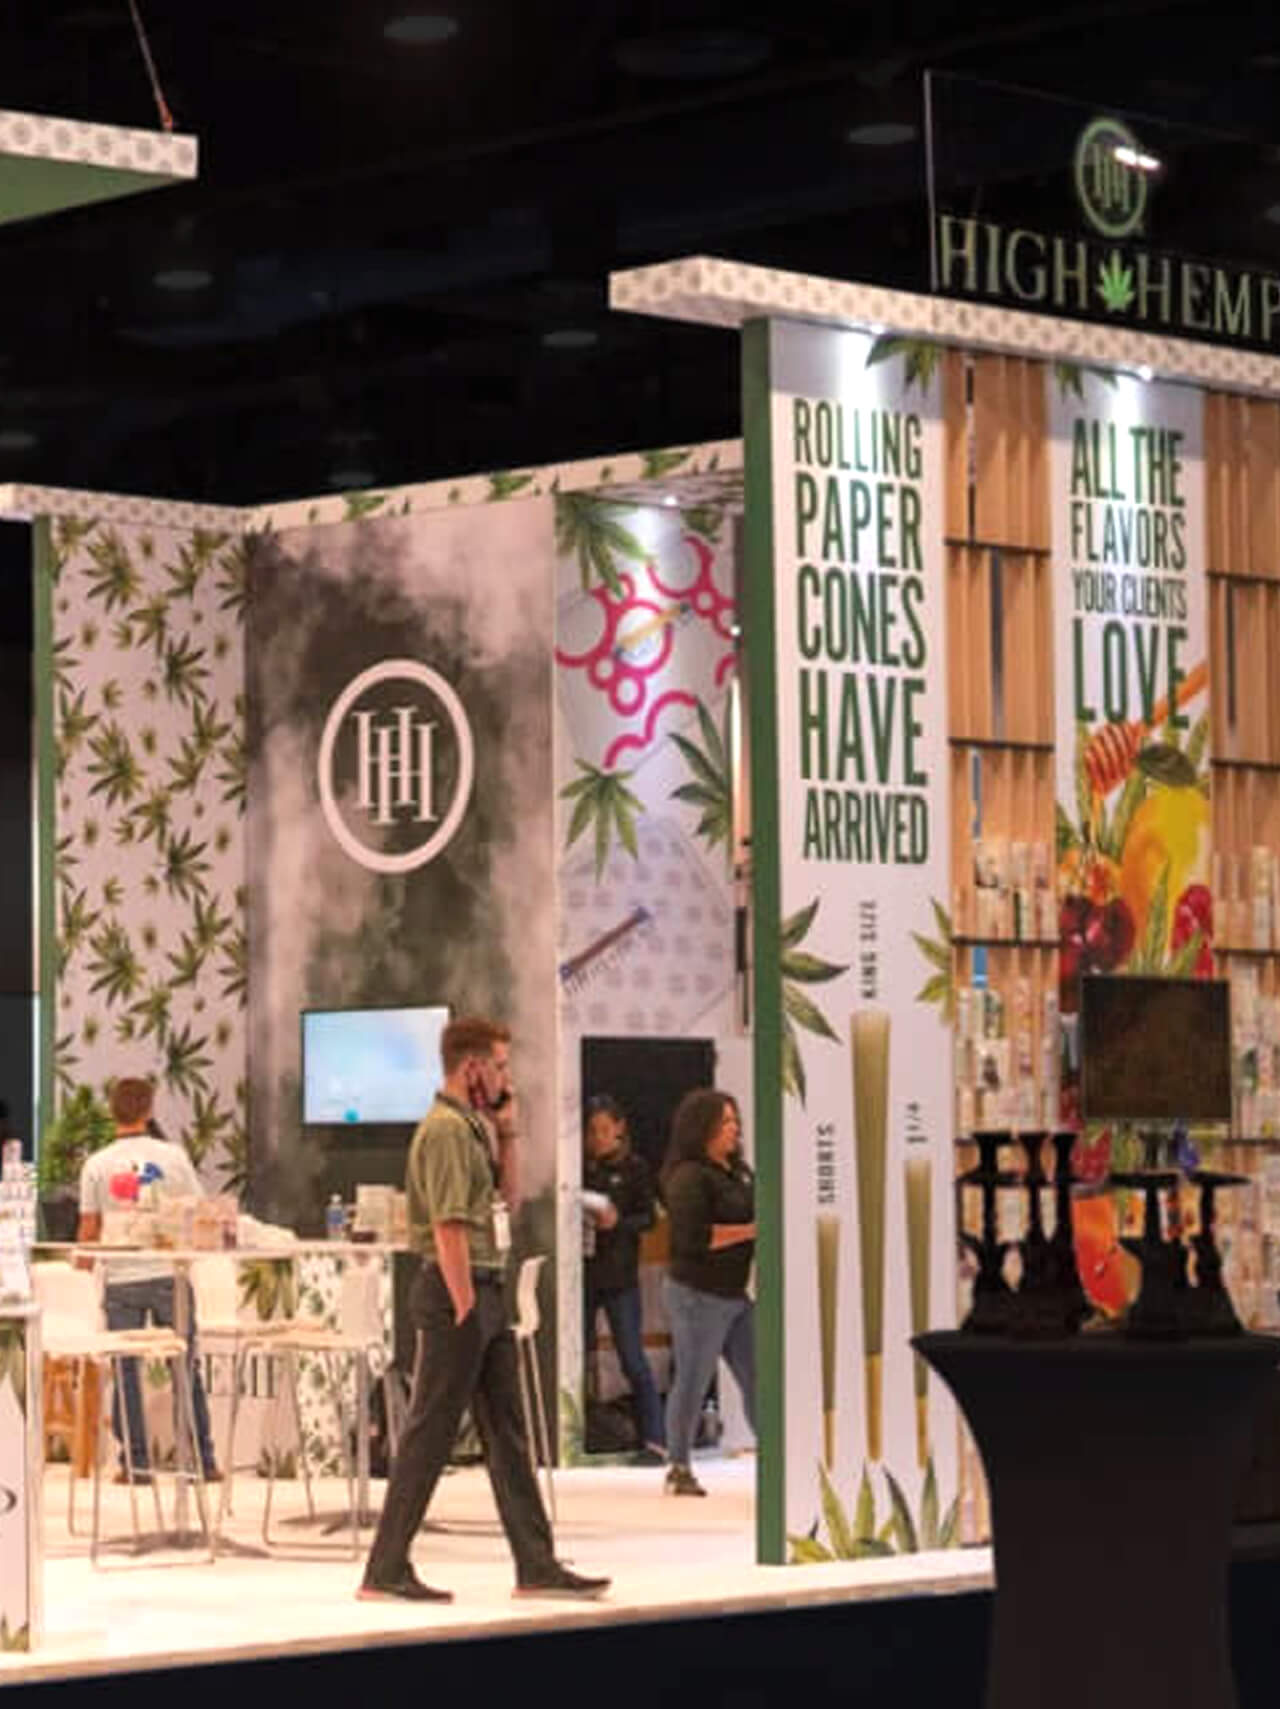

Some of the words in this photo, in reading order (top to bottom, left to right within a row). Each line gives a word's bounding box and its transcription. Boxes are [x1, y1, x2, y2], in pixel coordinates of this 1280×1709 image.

[940, 214, 1088, 309] HIGH
[794, 397, 923, 480] ROLLING
[1070, 417, 1125, 501] ALL
[1129, 425, 1185, 508] THE
[794, 470, 923, 573] PAPER
[1071, 500, 1186, 571] FLAVORS
[797, 563, 926, 669] CONES
[1072, 568, 1117, 613] YOUR
[1121, 571, 1187, 621] CLIENTS
[1073, 617, 1188, 730] LOVE
[799, 668, 928, 787] HAVE
[803, 788, 928, 865] ARRIVED
[859, 900, 878, 942] SIZE
[861, 951, 877, 999] KING
[817, 1123, 836, 1204] SHORTS
